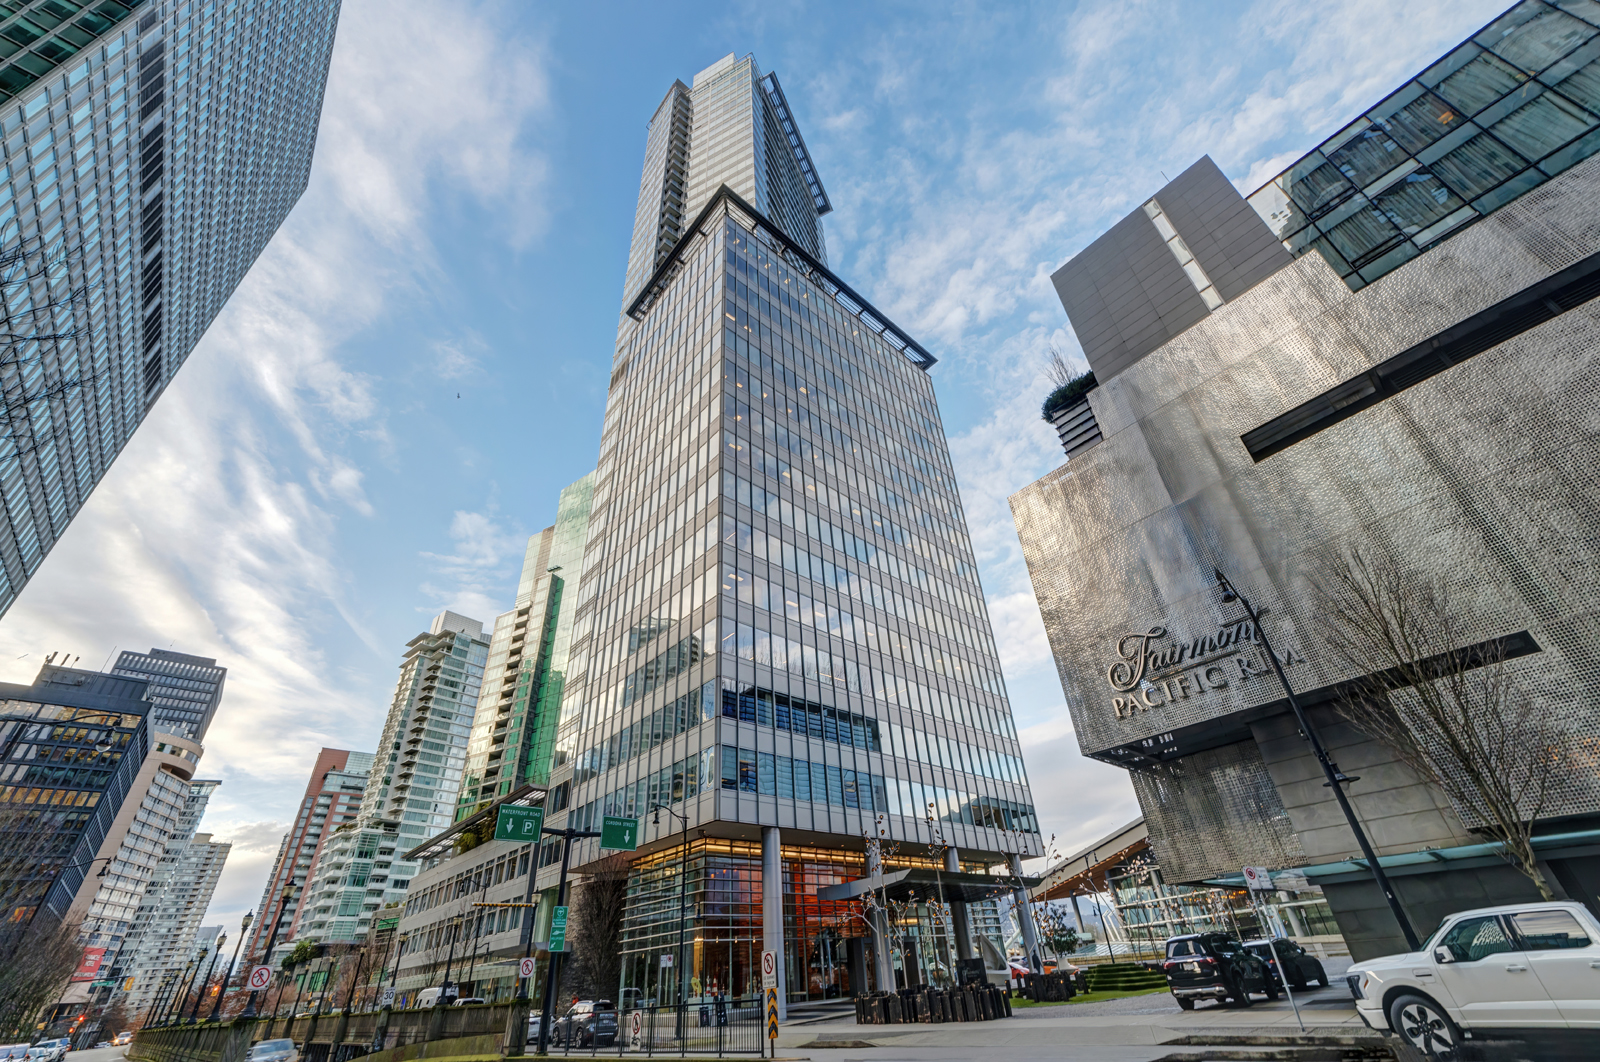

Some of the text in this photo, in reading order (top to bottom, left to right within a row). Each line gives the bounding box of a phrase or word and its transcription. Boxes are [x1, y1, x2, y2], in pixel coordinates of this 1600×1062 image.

[1108, 605, 1270, 692] Fairmont
[1111, 665, 1228, 719] PACIFIC
[501, 808, 529, 816] WATERFRONT
[523, 821, 533, 833] P
[384, 991, 394, 1000] 30
